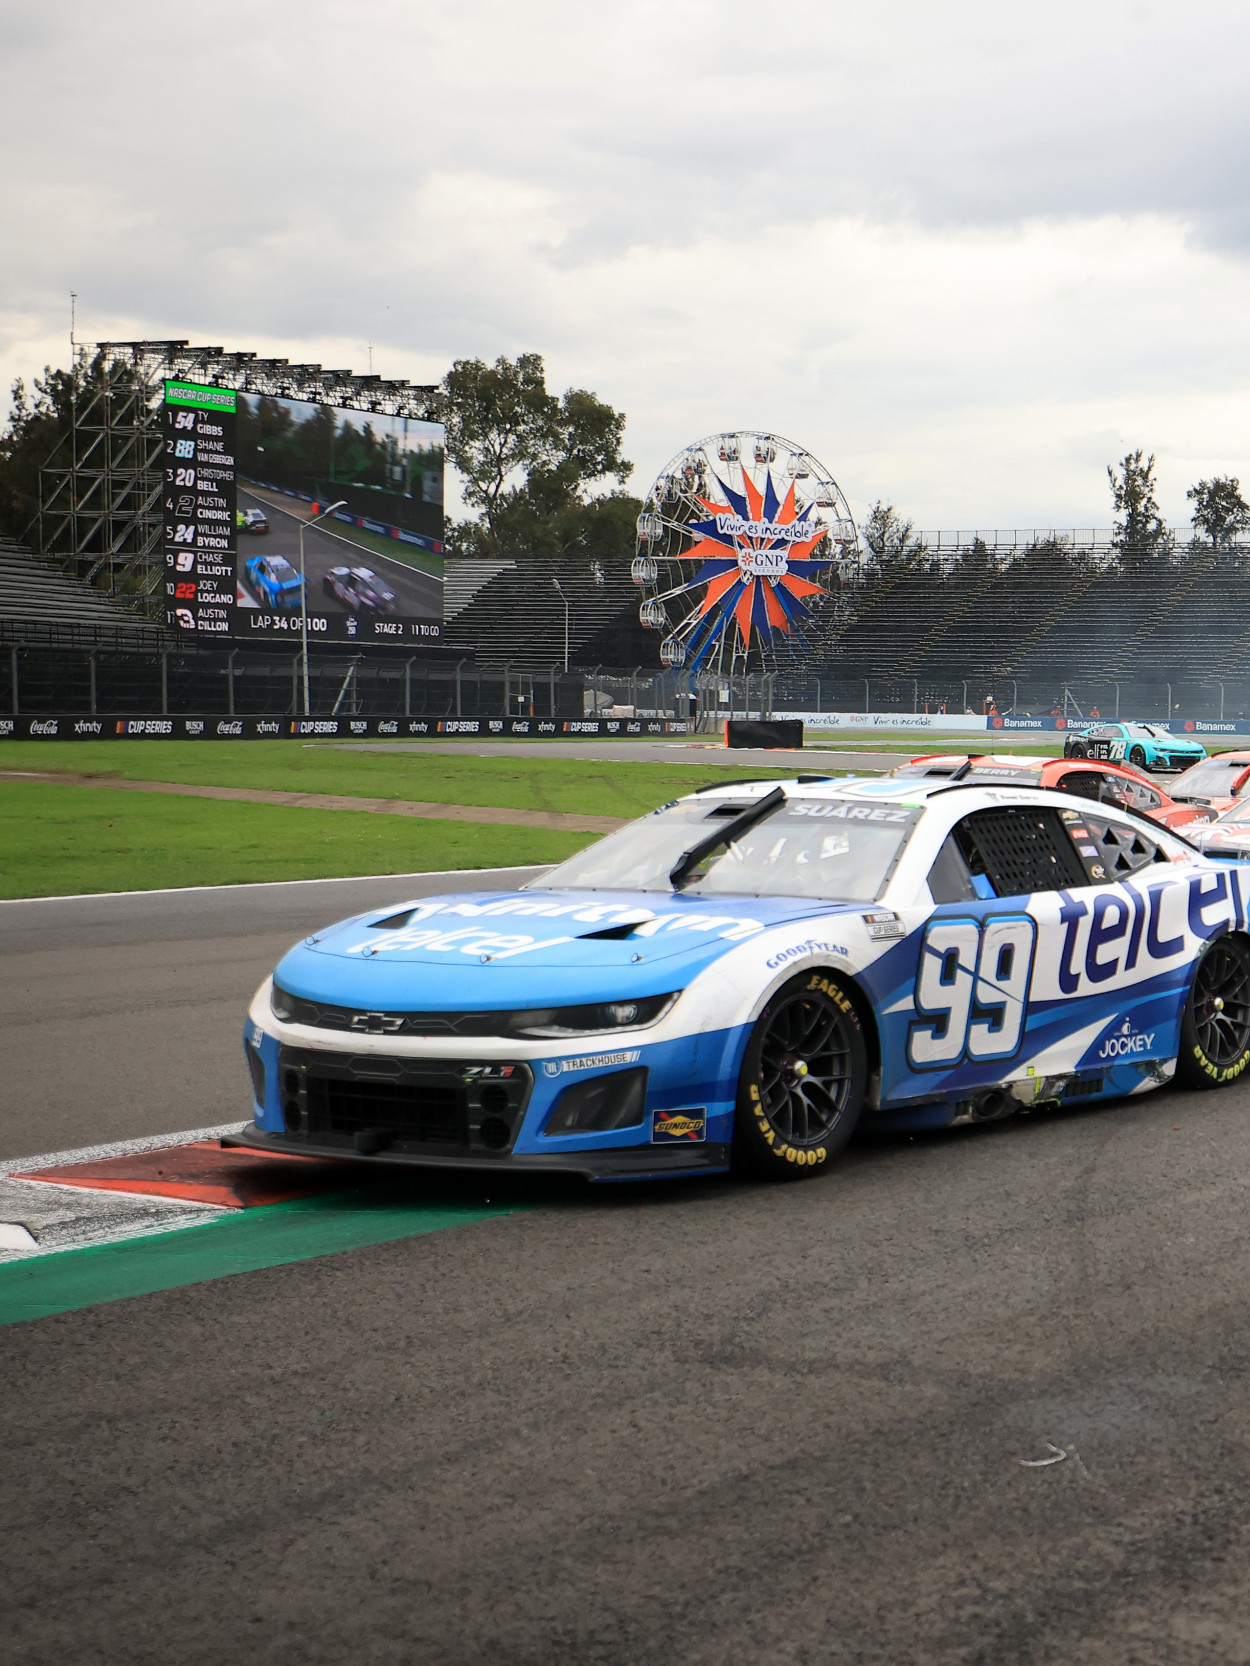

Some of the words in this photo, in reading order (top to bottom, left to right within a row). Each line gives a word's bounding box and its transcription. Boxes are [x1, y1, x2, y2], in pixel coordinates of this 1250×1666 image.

[168, 387, 197, 400] NASCAR
[197, 391, 211, 402] CUP
[212, 394, 235, 406] SERIES
[168, 411, 173, 424] 1
[175, 411, 195, 430] 54
[197, 410, 209, 421] TY
[197, 424, 223, 436] GIBBS
[166, 440, 174, 453] 2
[175, 440, 195, 459] 88
[197, 440, 224, 452] SHANE
[197, 452, 208, 462] VAN
[166, 468, 174, 482] 3
[175, 468, 195, 487] 20
[197, 467, 234, 481] CHRISTOPHER
[197, 480, 219, 492] BELL
[166, 497, 174, 510] 4
[175, 495, 196, 517] 2
[197, 496, 227, 508] AUSTIN
[197, 508, 231, 521] CINDRIC
[166, 525, 174, 539] 5
[197, 523, 231, 536] WILLIAM
[718, 517, 745, 531] Vivir
[748, 525, 758, 535] es
[174, 524, 195, 543] 24
[197, 536, 228, 549] BYRON
[166, 554, 174, 567] 9
[176, 552, 195, 572] 9
[197, 552, 224, 564] CHASE
[754, 553, 783, 567] GNP
[197, 564, 233, 577] ELLIOTT
[166, 582, 175, 595] 10
[175, 582, 197, 599] 22
[197, 580, 219, 591] JOEY
[197, 592, 234, 604] LOGANO
[175, 608, 196, 629] 3
[198, 608, 227, 619] AUSTIN
[198, 620, 229, 632] DILLON
[250, 615, 272, 629] LAP
[273, 616, 288, 630] 34
[290, 617, 304, 631] OF
[307, 618, 327, 631] 100
[374, 622, 397, 634] STAGE
[398, 624, 403, 634] 2
[411, 624, 419, 636] 11
[420, 625, 429, 636] TO
[430, 626, 439, 636] GO
[0, 720, 14, 731] SCH
[74, 720, 102, 734] xfinity
[128, 721, 145, 734] CUP
[144, 721, 173, 734] SERIES
[185, 720, 204, 732] BUSCH
[256, 720, 280, 734] xfinity
[300, 721, 314, 734] CUP
[314, 721, 338, 733] SERIES
[350, 721, 368, 730] BUSCH
[408, 721, 429, 733] xfinity
[445, 721, 459, 733] CUP
[459, 721, 480, 733] SERIES
[488, 721, 503, 730] BUSCH
[570, 722, 582, 732] CUP
[581, 722, 600, 732] SERIES
[873, 717, 890, 726] Vivir
[1004, 718, 1042, 728] Banamex
[1195, 721, 1236, 732] Banamex
[1087, 743, 1100, 760] elf
[1109, 740, 1127, 760] 78
[974, 767, 1020, 776] BERRY
[789, 803, 912, 823] SUÁREZ
[1059, 868, 1245, 994] telcel
[766, 940, 850, 969] GOODYEAR
[808, 974, 853, 1013] EAGLE
[907, 912, 1038, 1074] 99
[1099, 1033, 1155, 1058] JOCKEY
[565, 1053, 629, 1070] TRACKHOUSE
[461, 1066, 515, 1078] ZL1
[657, 1120, 702, 1132] SUNOCO
[750, 1084, 827, 1165] GOODYEAR
